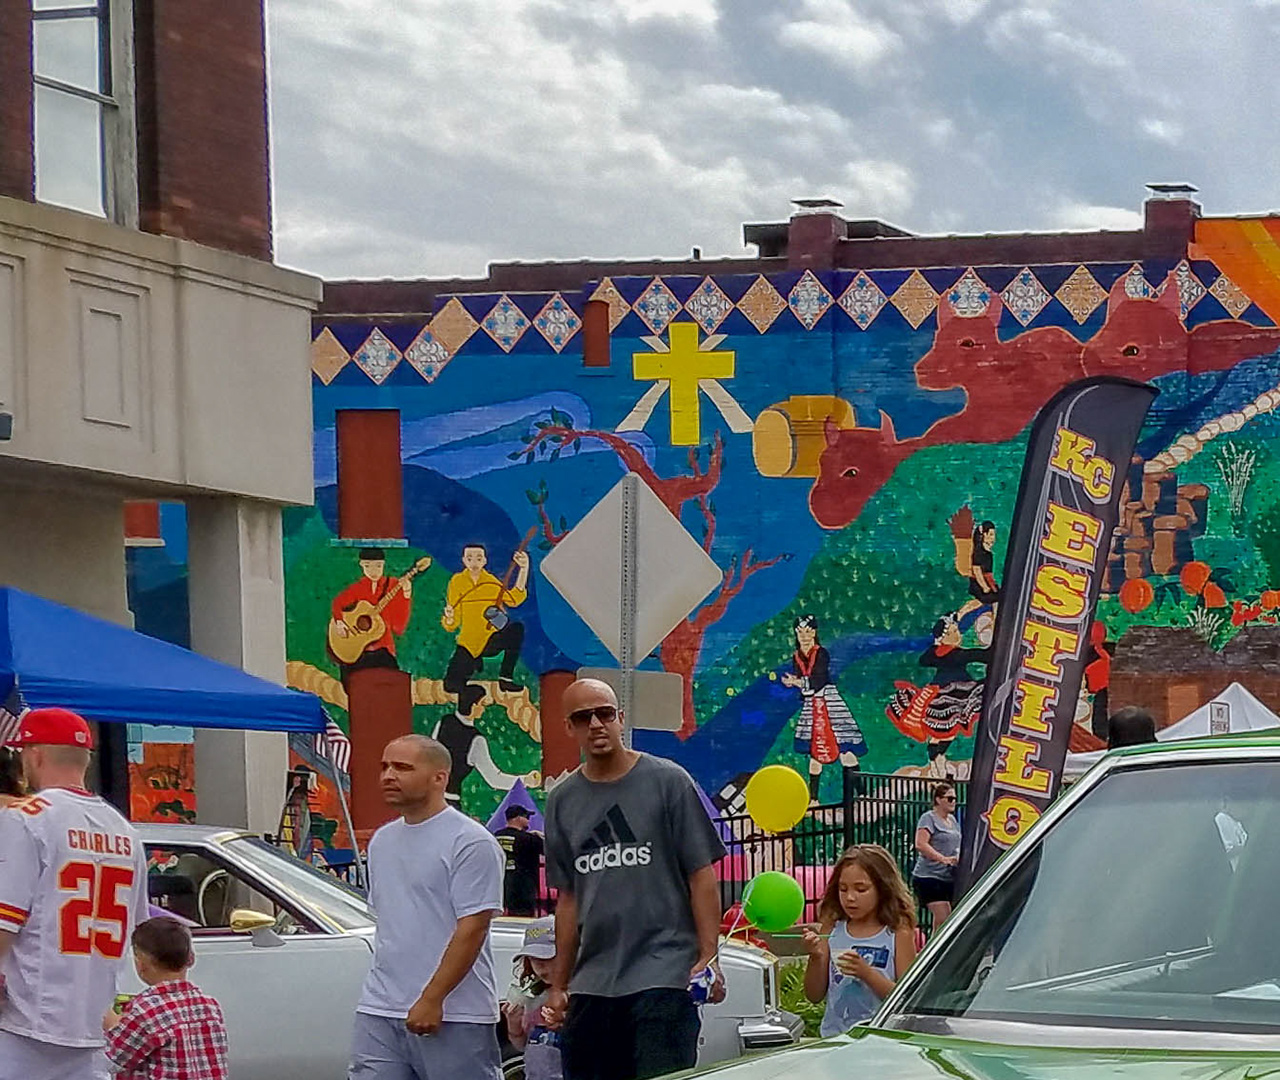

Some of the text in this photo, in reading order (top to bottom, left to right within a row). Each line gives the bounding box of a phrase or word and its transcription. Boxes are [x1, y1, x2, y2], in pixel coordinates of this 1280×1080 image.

[1050, 425, 1114, 501] KC
[986, 502, 1101, 848] ESTILO
[574, 842, 652, 874] adidas
[59, 860, 135, 960] 25
